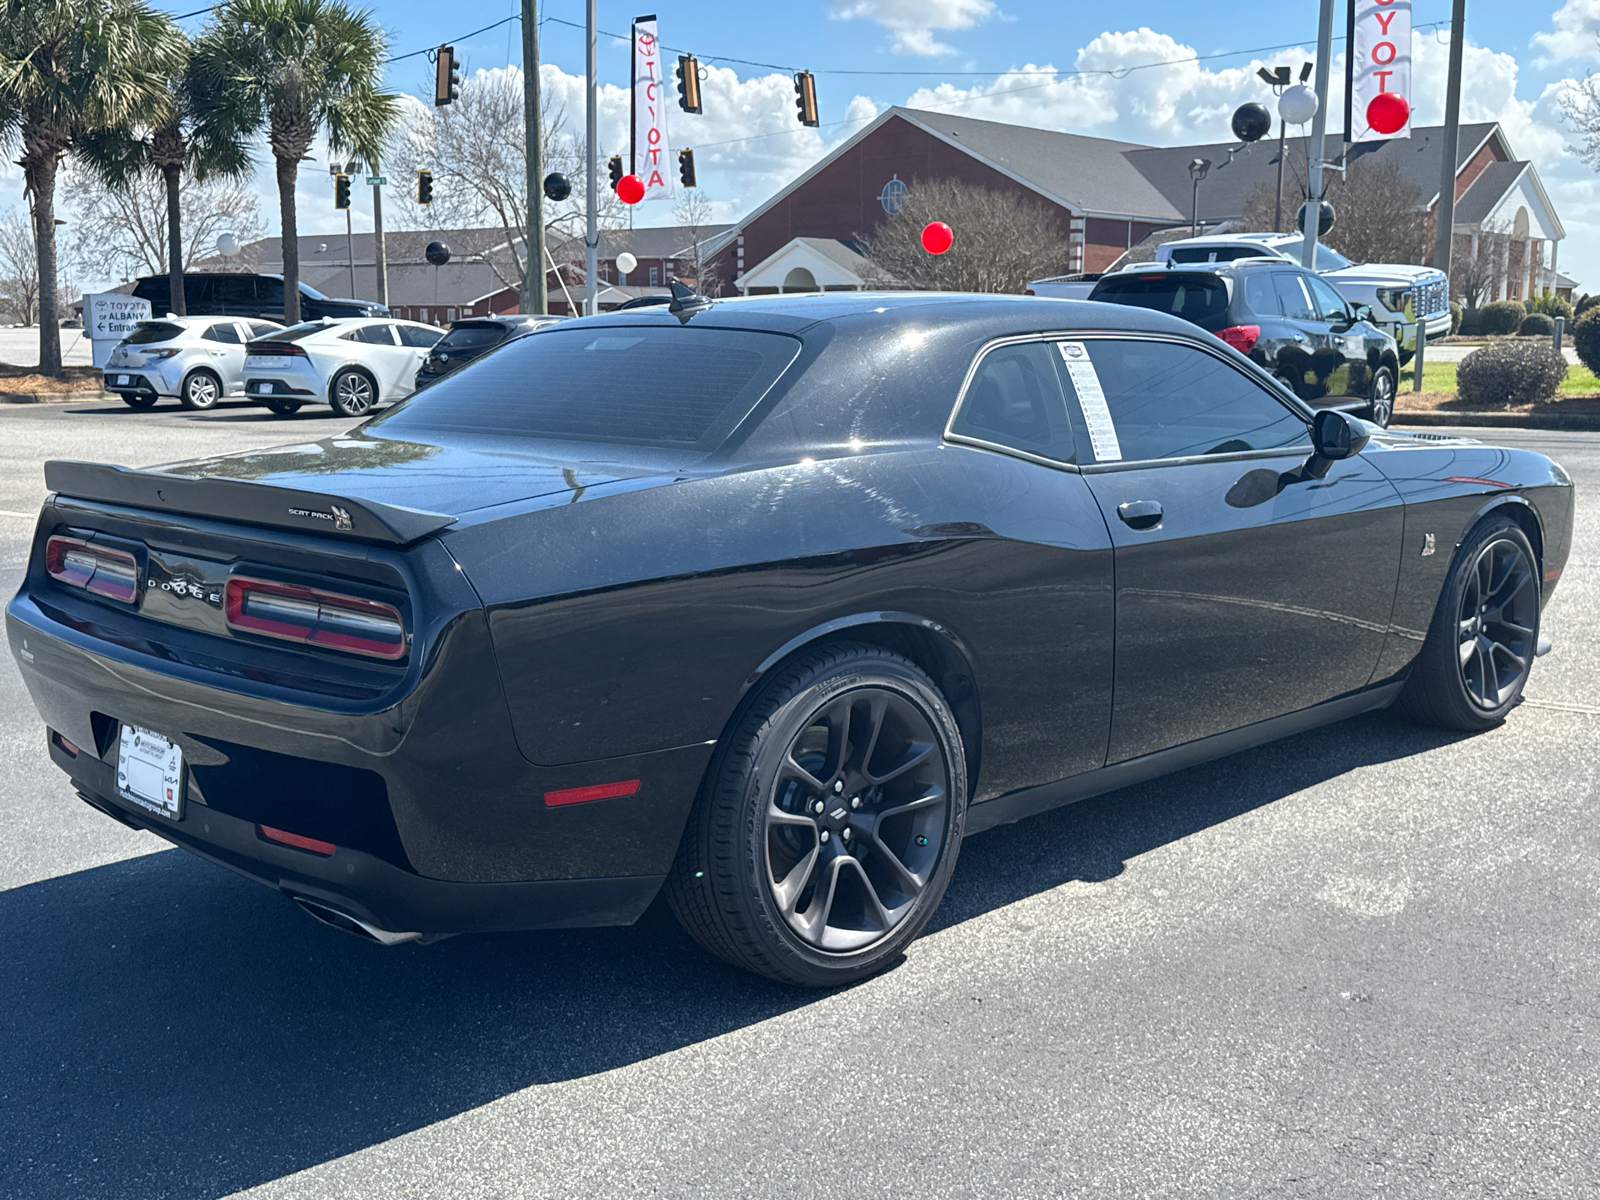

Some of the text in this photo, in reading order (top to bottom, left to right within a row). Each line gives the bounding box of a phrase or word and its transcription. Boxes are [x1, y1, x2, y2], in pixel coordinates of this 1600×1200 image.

[1371, 0, 1397, 93] YOT
[110, 302, 146, 310] TOYOTA
[109, 312, 144, 320] ALBANY
[108, 322, 137, 332] Entran
[288, 508, 334, 521] SCAT PACK
[147, 579, 220, 602] DODGE
